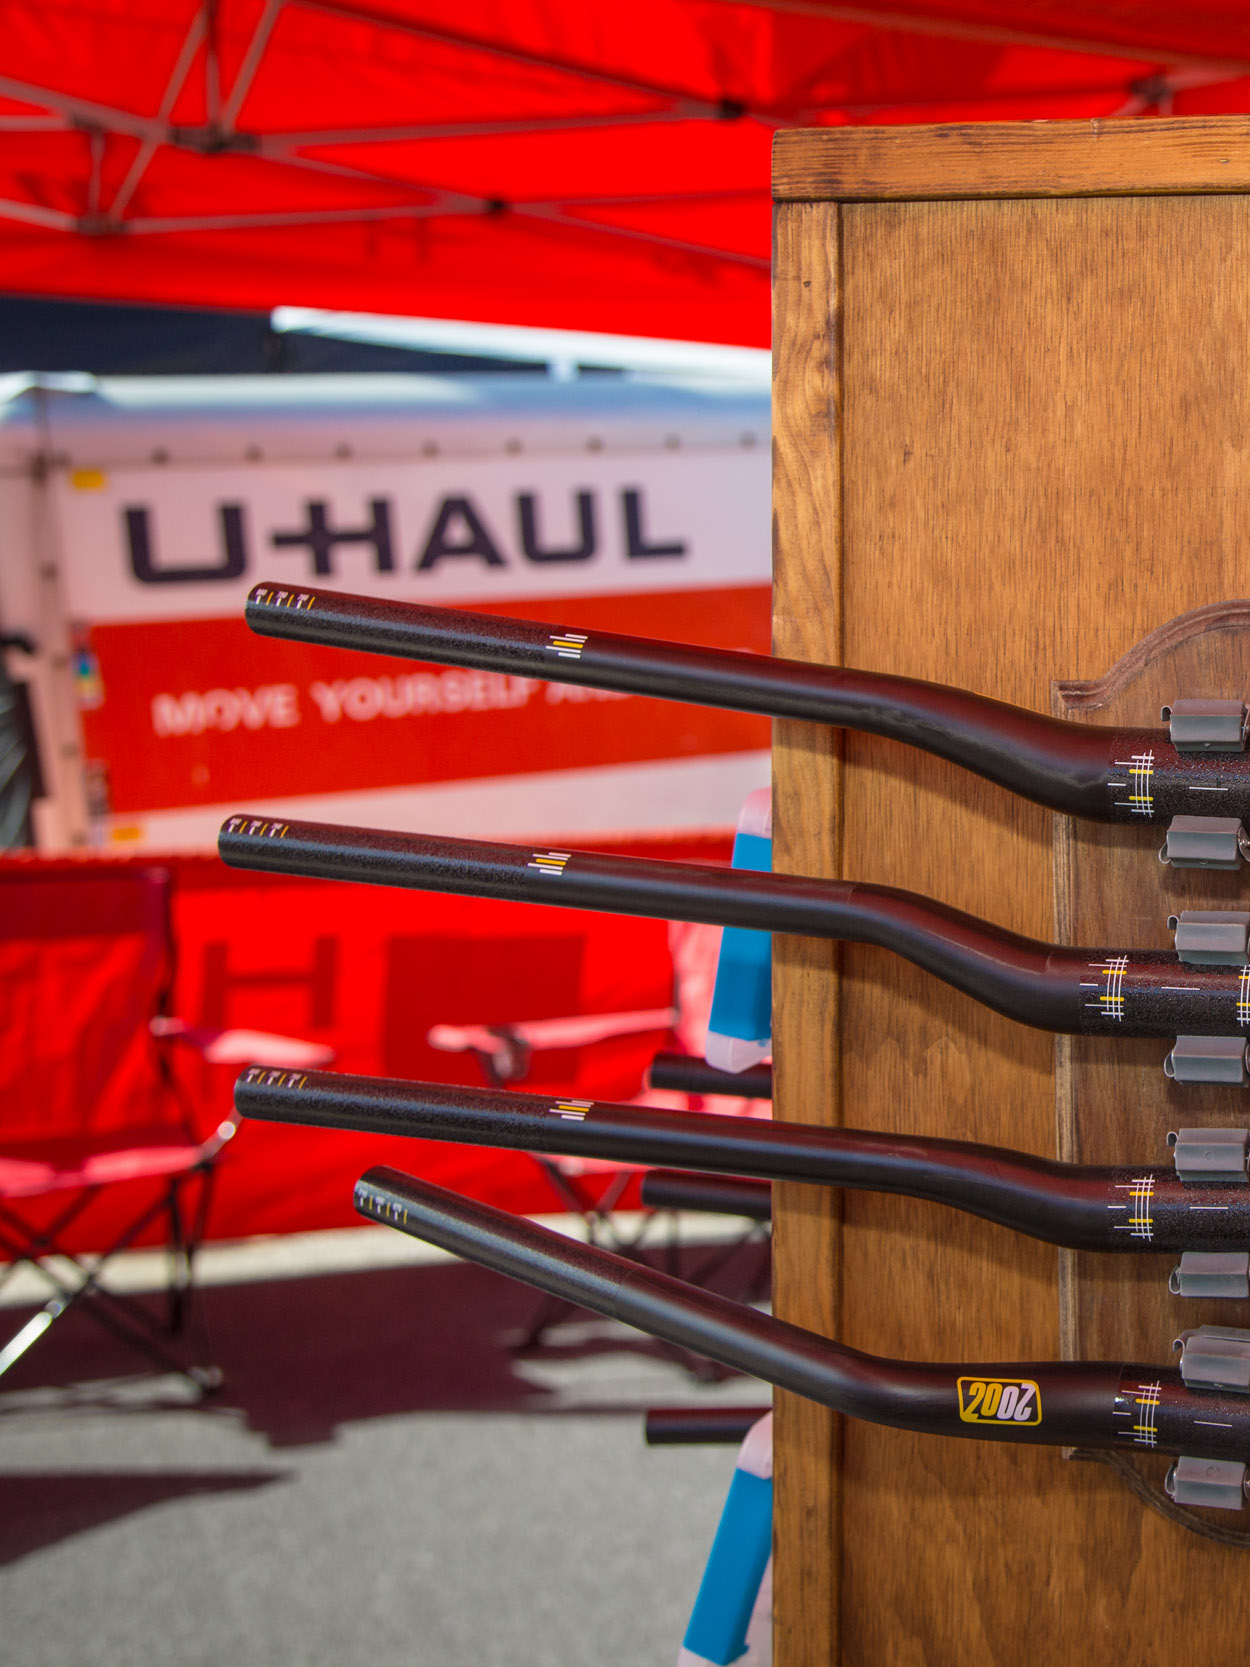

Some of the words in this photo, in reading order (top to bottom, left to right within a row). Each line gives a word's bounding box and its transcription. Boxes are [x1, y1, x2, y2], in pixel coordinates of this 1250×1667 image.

[122, 487, 687, 584] U-HAUL
[152, 683, 300, 737] MOVE
[310, 669, 538, 722] YOURSELF
